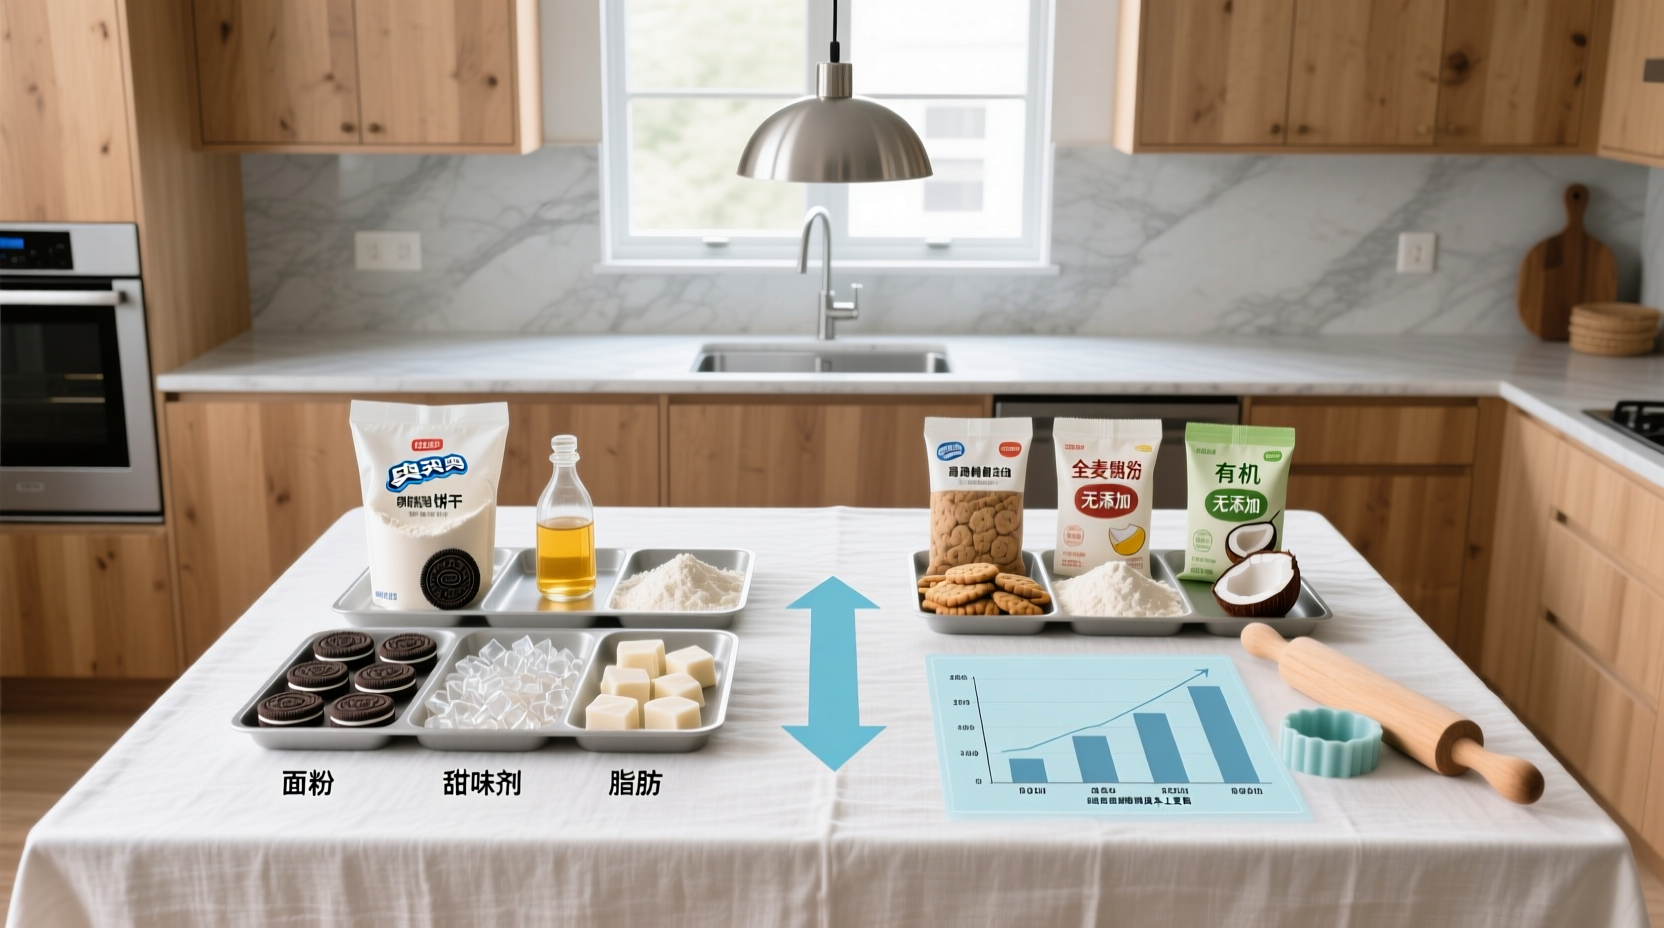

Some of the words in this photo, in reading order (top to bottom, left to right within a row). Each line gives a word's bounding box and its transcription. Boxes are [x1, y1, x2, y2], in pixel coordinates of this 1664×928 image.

[1215, 462, 1261, 485] 有机
[1081, 491, 1131, 509] 无添加
[1212, 495, 1260, 514] 无添加
[282, 769, 334, 796] 面粉
[442, 769, 522, 796] 甜味剂
[608, 769, 663, 796] 脂肪
